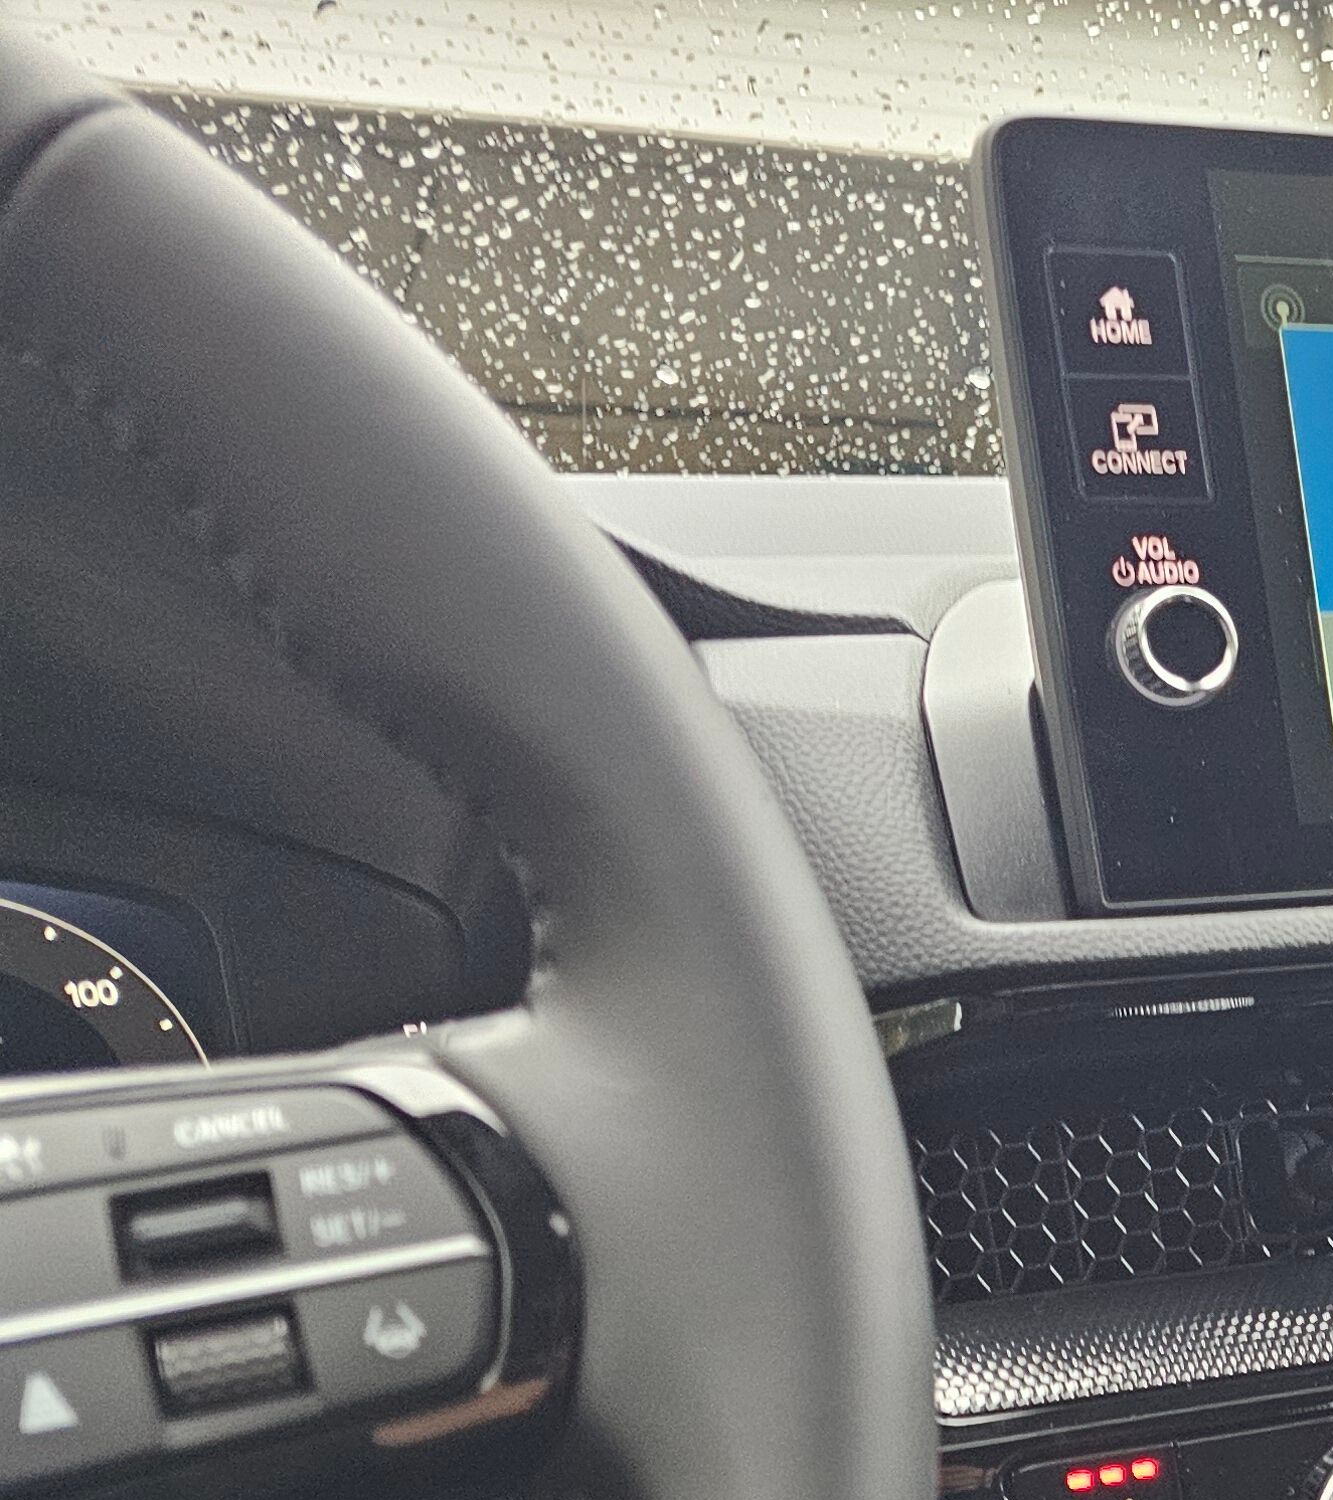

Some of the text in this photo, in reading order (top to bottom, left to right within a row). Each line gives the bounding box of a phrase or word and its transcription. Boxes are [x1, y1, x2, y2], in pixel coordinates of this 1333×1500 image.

[1090, 317, 1153, 345] HOME
[1092, 450, 1188, 475] CONNECT
[1132, 536, 1175, 561] VOL
[1137, 560, 1200, 585] AUDIO
[64, 979, 119, 1008] 100
